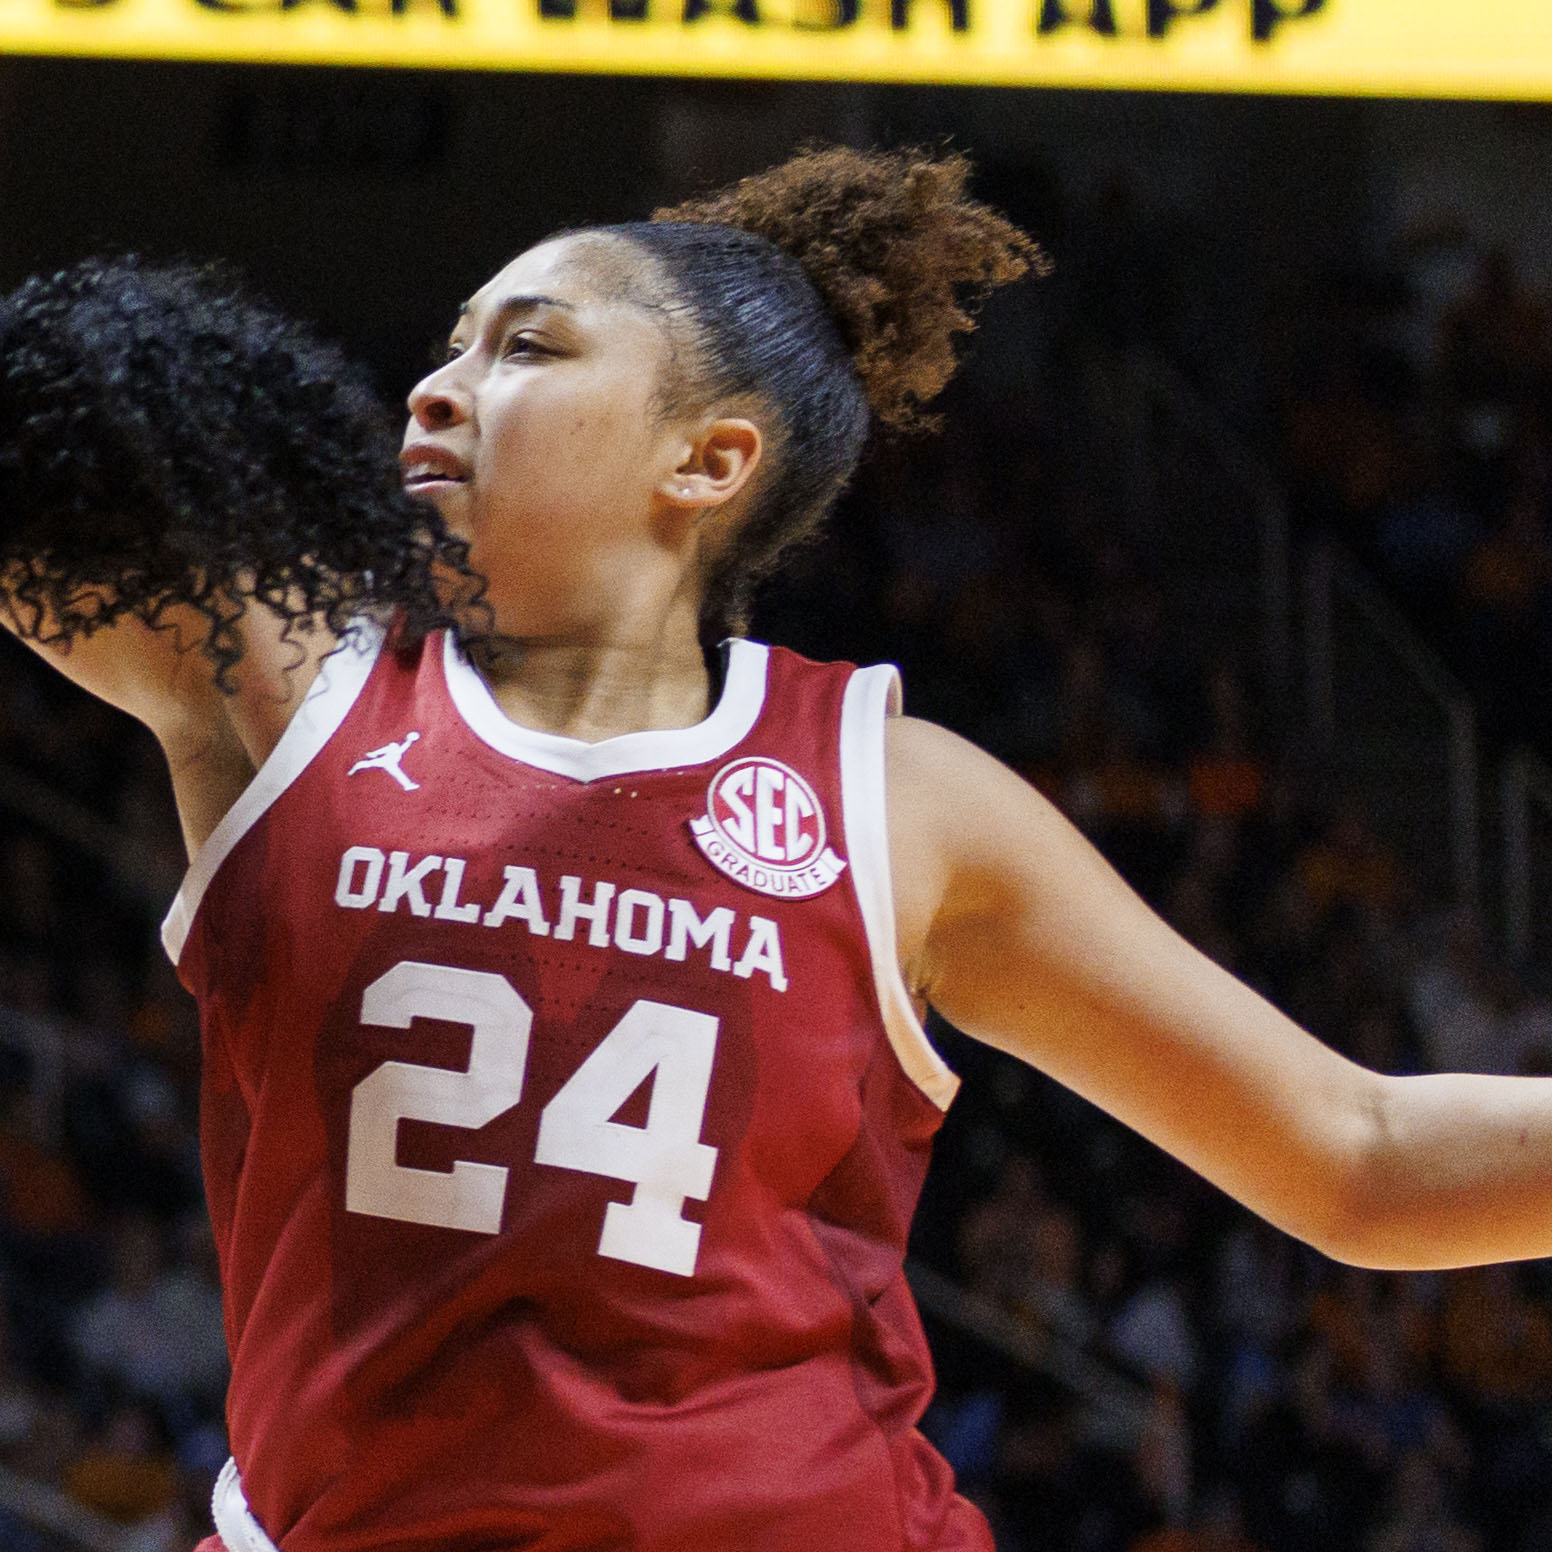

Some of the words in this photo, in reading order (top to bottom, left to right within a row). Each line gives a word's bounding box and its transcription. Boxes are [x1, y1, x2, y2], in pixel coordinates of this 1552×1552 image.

[707, 840, 827, 893] GRADUATE
[719, 765, 815, 862] SEC
[334, 845, 789, 993] OKLAHOMA
[346, 960, 721, 1278] 24
